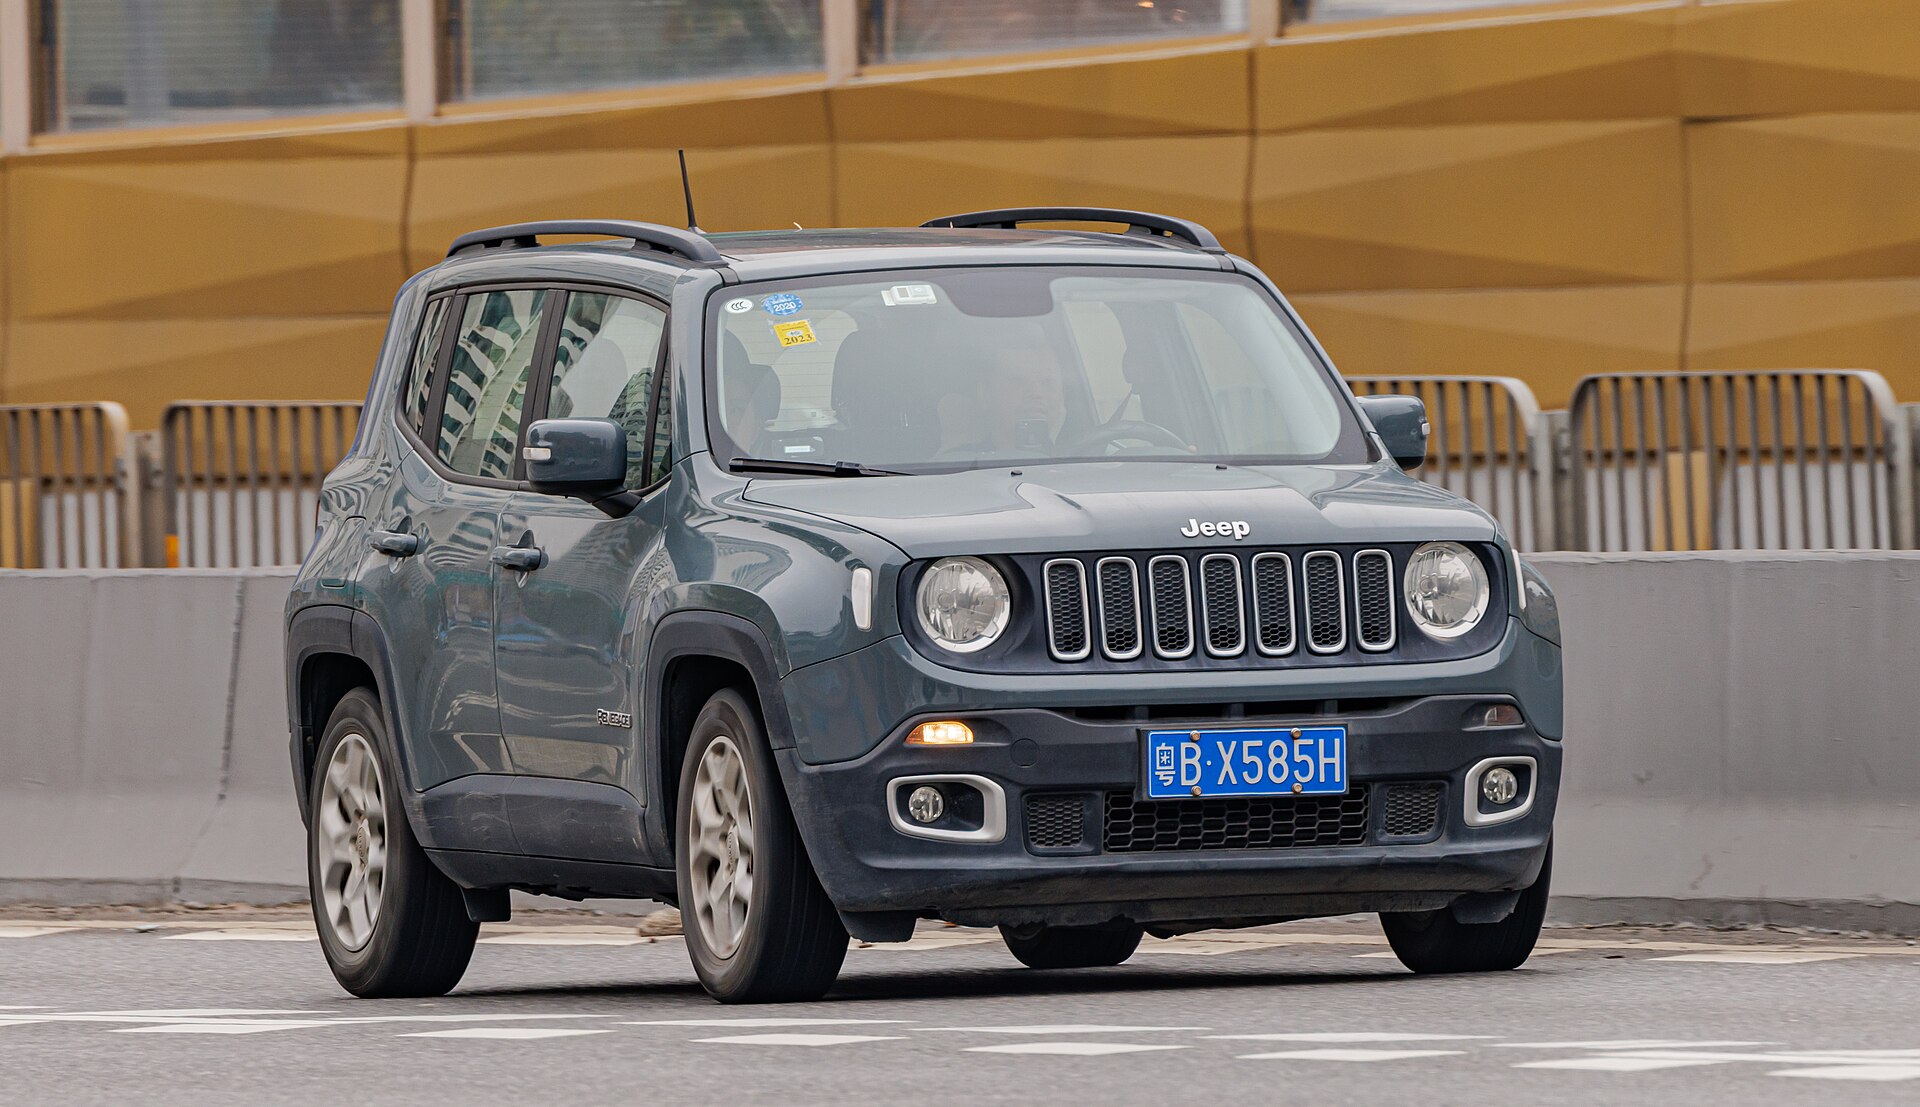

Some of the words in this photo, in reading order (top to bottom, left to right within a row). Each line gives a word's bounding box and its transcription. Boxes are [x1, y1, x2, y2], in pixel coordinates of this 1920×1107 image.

[773, 302, 796, 312] 2020
[784, 333, 812, 345] 2023
[1180, 518, 1251, 541] Jeep
